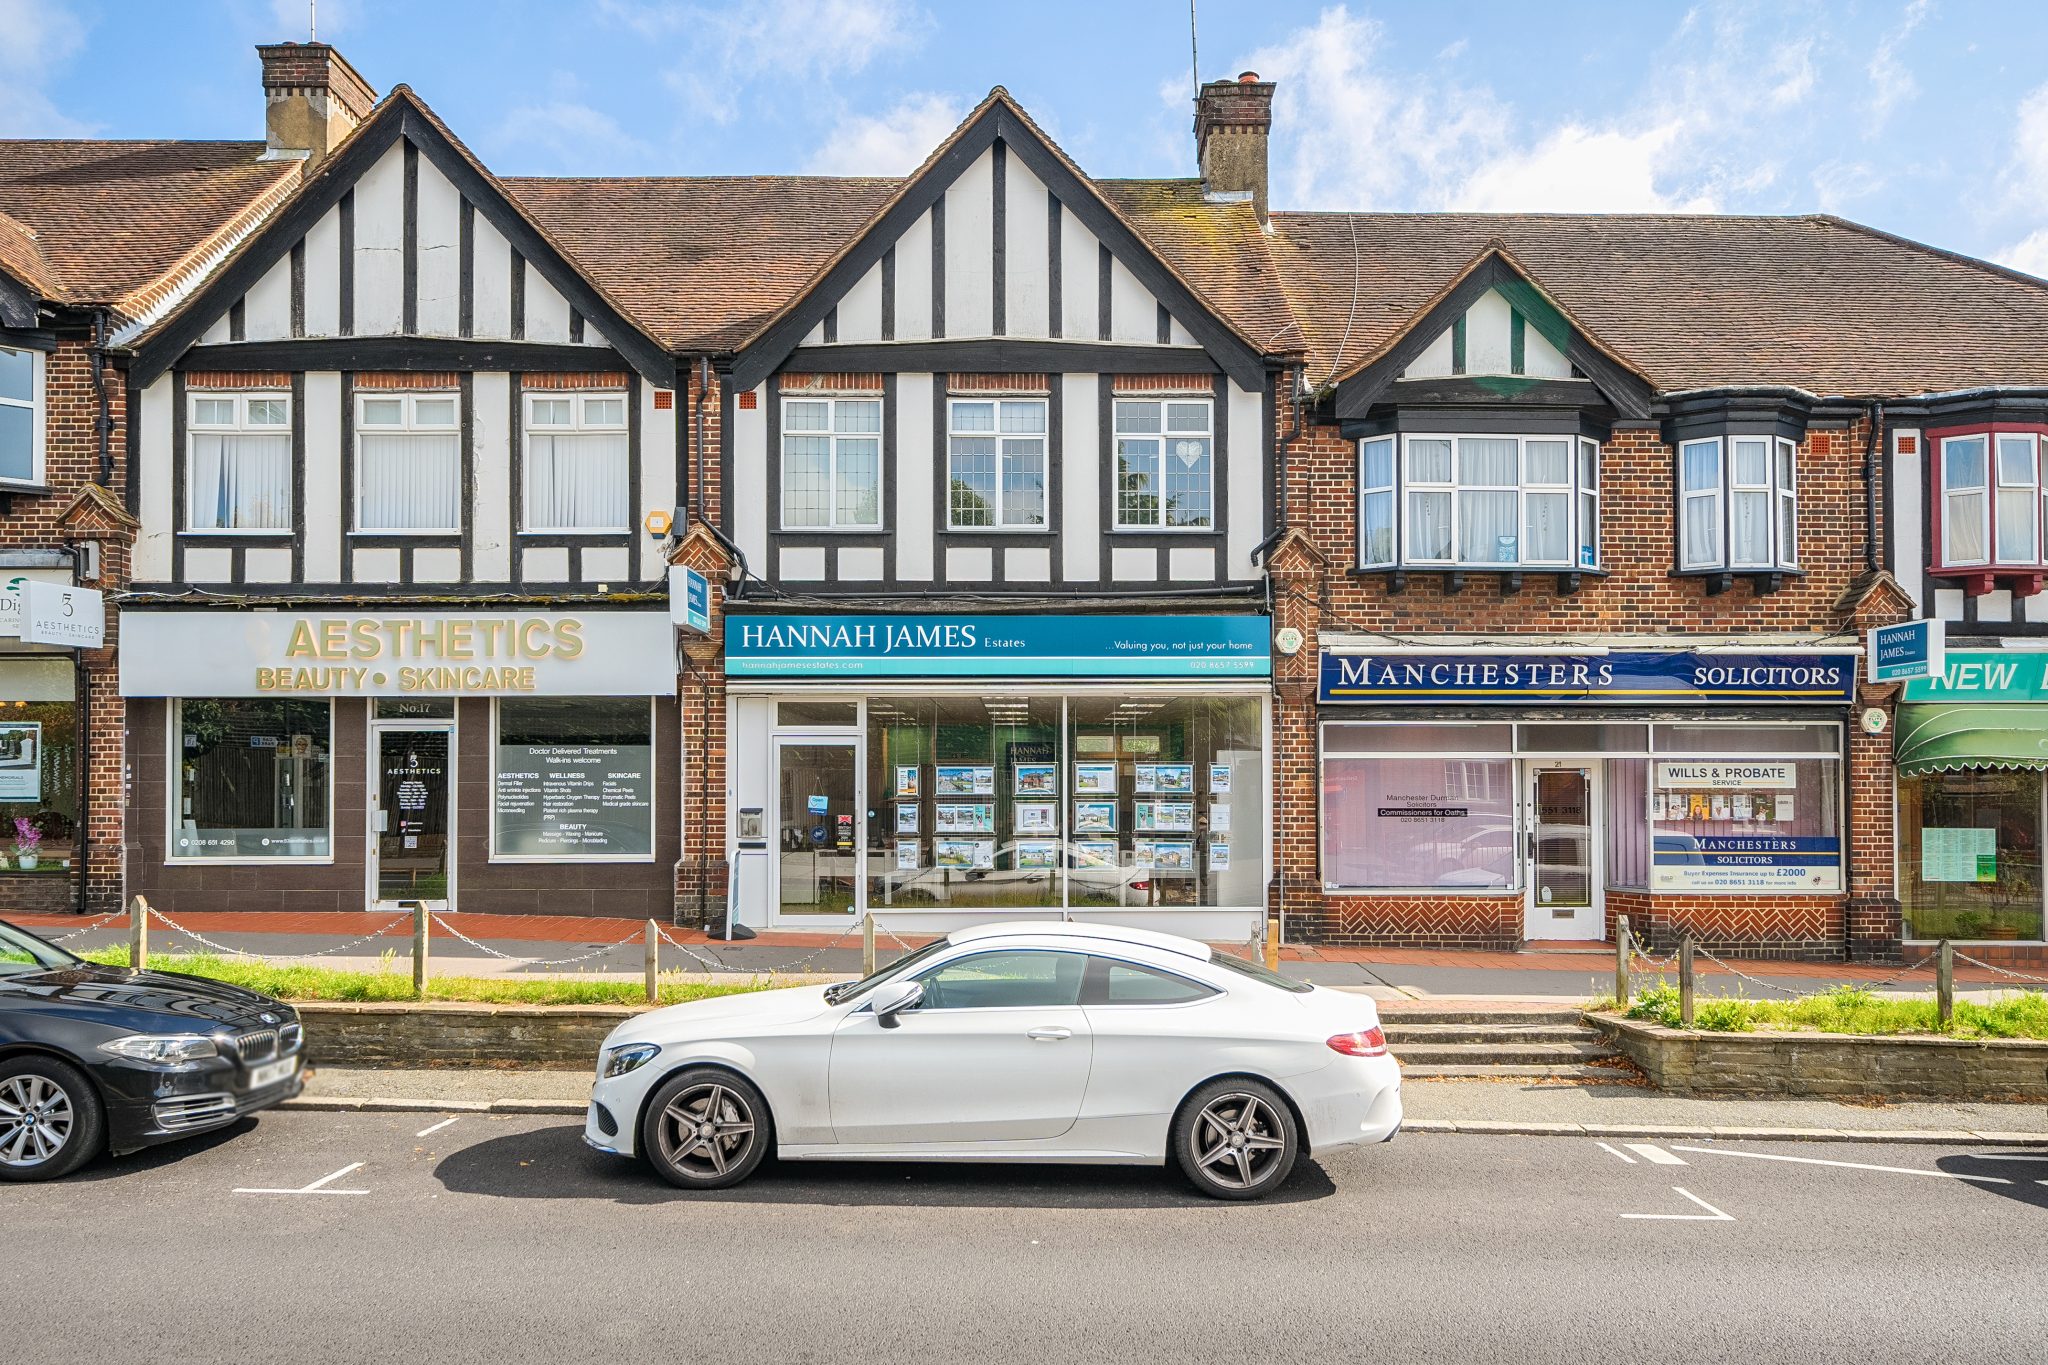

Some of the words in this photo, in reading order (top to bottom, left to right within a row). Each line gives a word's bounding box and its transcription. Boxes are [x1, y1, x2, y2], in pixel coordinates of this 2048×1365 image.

[36, 620, 100, 635] AESTHETICS
[285, 618, 584, 659] AESTHETICS
[742, 625, 876, 648] HANNAH
[884, 624, 976, 654] JAMES
[984, 638, 1026, 648] Estates
[1880, 630, 1915, 645] HANNAH
[1150, 642, 1169, 652] you,
[1172, 641, 1186, 650] not
[1188, 640, 1204, 652] just
[1206, 642, 1226, 652] your
[1229, 640, 1253, 650] home
[1880, 647, 1904, 661] JAMES
[742, 662, 863, 672] hannahjamesestates.com
[256, 667, 366, 690] BEAUTY
[399, 667, 536, 690] SKINCARE
[1694, 667, 1840, 686] SOLICITORS
[1929, 664, 2018, 690] NEW
[400, 704, 431, 713] No.17
[1010, 746, 1050, 754] HANNAH
[1668, 768, 1707, 778] WILLS
[1711, 768, 1720, 778] &
[1725, 768, 1785, 778] PROBATE
